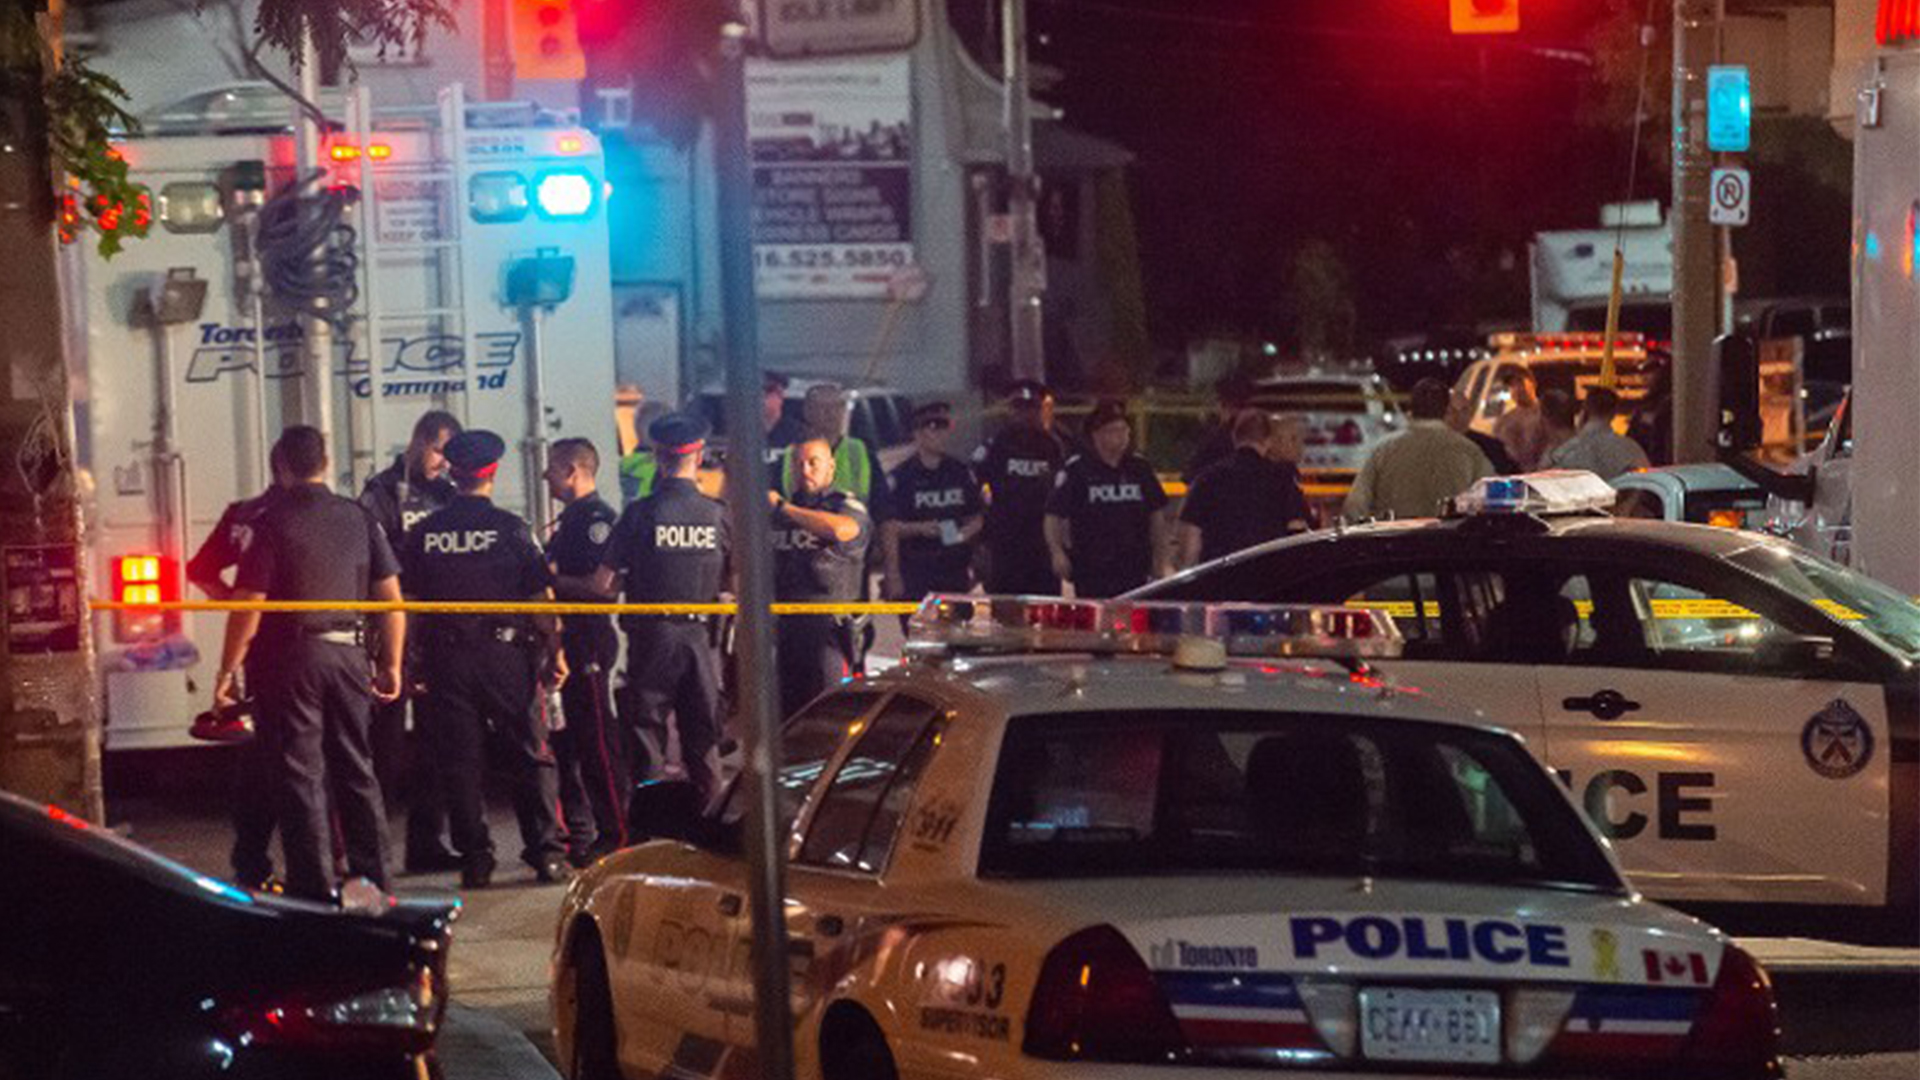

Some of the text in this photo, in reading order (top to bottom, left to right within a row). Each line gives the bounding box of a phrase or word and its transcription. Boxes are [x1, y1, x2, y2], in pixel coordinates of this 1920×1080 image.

[772, 170, 863, 185] BANNERS
[833, 224, 901, 240] CARDS
[753, 250, 905, 267] 16.525.5850
[915, 489, 965, 507] POLICE
[1089, 485, 1143, 501] POLICE
[656, 526, 716, 549] POLICE
[1289, 916, 1571, 967] POLICE
[1179, 941, 1259, 968] TORONTO
